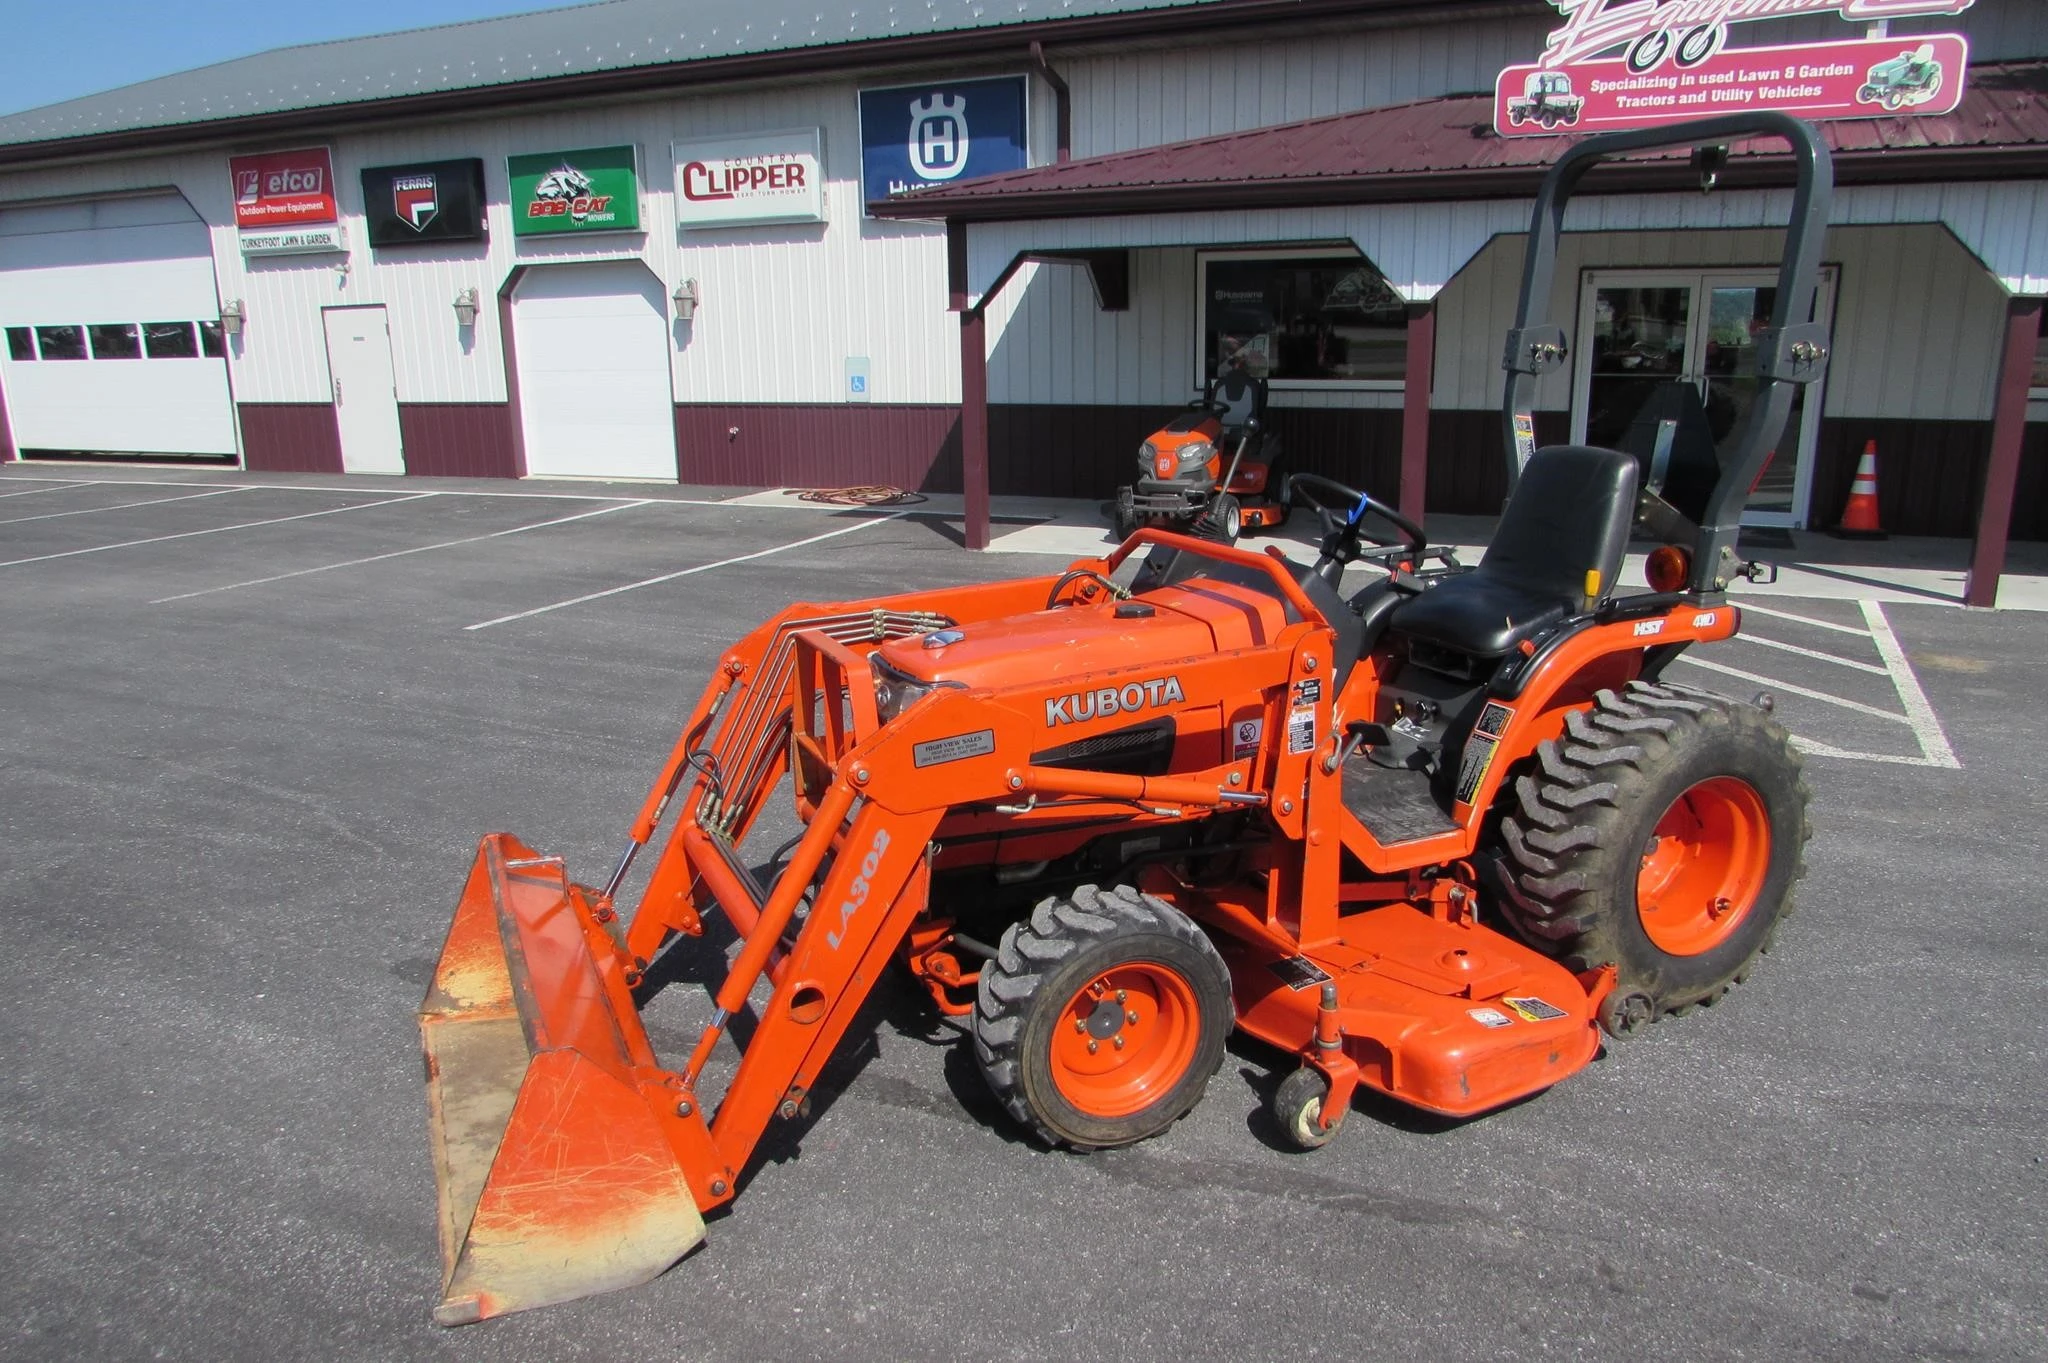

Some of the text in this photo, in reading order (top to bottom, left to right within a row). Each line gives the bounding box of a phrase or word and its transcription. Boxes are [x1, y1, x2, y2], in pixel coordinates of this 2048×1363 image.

[1590, 63, 1854, 94] Specializing in used Lawn & Garden
[1616, 84, 1823, 108] Tractors and Utility Vehicles
[723, 152, 797, 168] COUNTRY
[269, 169, 315, 192] efco
[396, 177, 433, 191] FERRIS
[683, 161, 806, 201] CLIPPER
[780, 188, 807, 196] MOWER
[239, 201, 325, 216] Outdoor Power Equipment
[587, 212, 615, 222] MOWERS
[241, 233, 332, 249] TURKEYFOOT LAWN & GARDEN
[1633, 619, 1665, 637] HST
[1045, 675, 1186, 727] KUBOTA
[943, 739, 960, 748] VIEW
[962, 736, 983, 744] SALES
